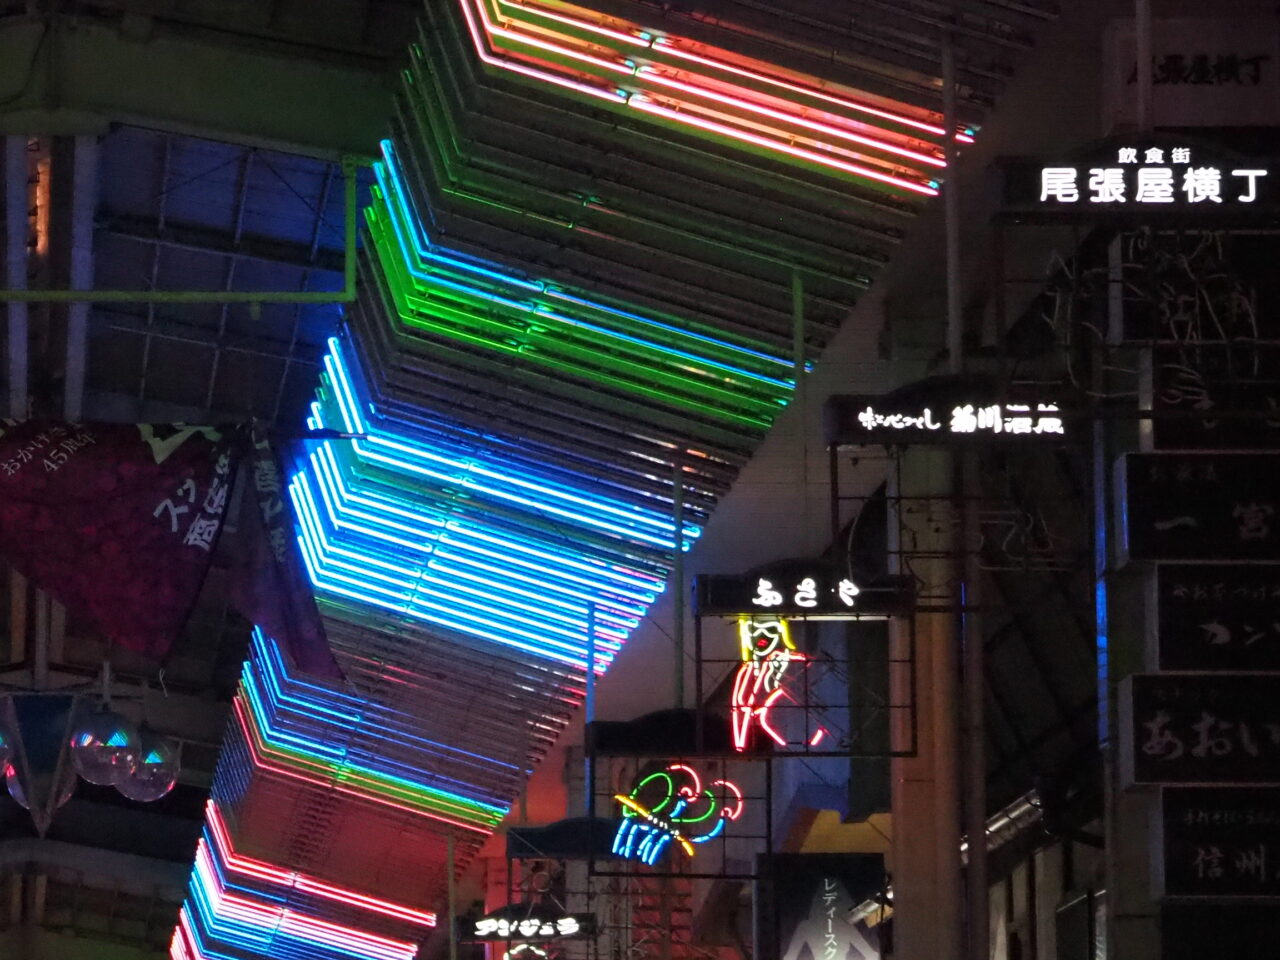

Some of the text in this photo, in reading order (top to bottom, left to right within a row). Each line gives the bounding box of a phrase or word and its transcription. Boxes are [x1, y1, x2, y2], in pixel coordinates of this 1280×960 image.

[1127, 54, 1270, 85] 張屋横丁
[1118, 147, 1191, 164] 飲食街
[1040, 167, 1268, 203] 尾張屋横丁
[1193, 844, 1280, 883] 信州
